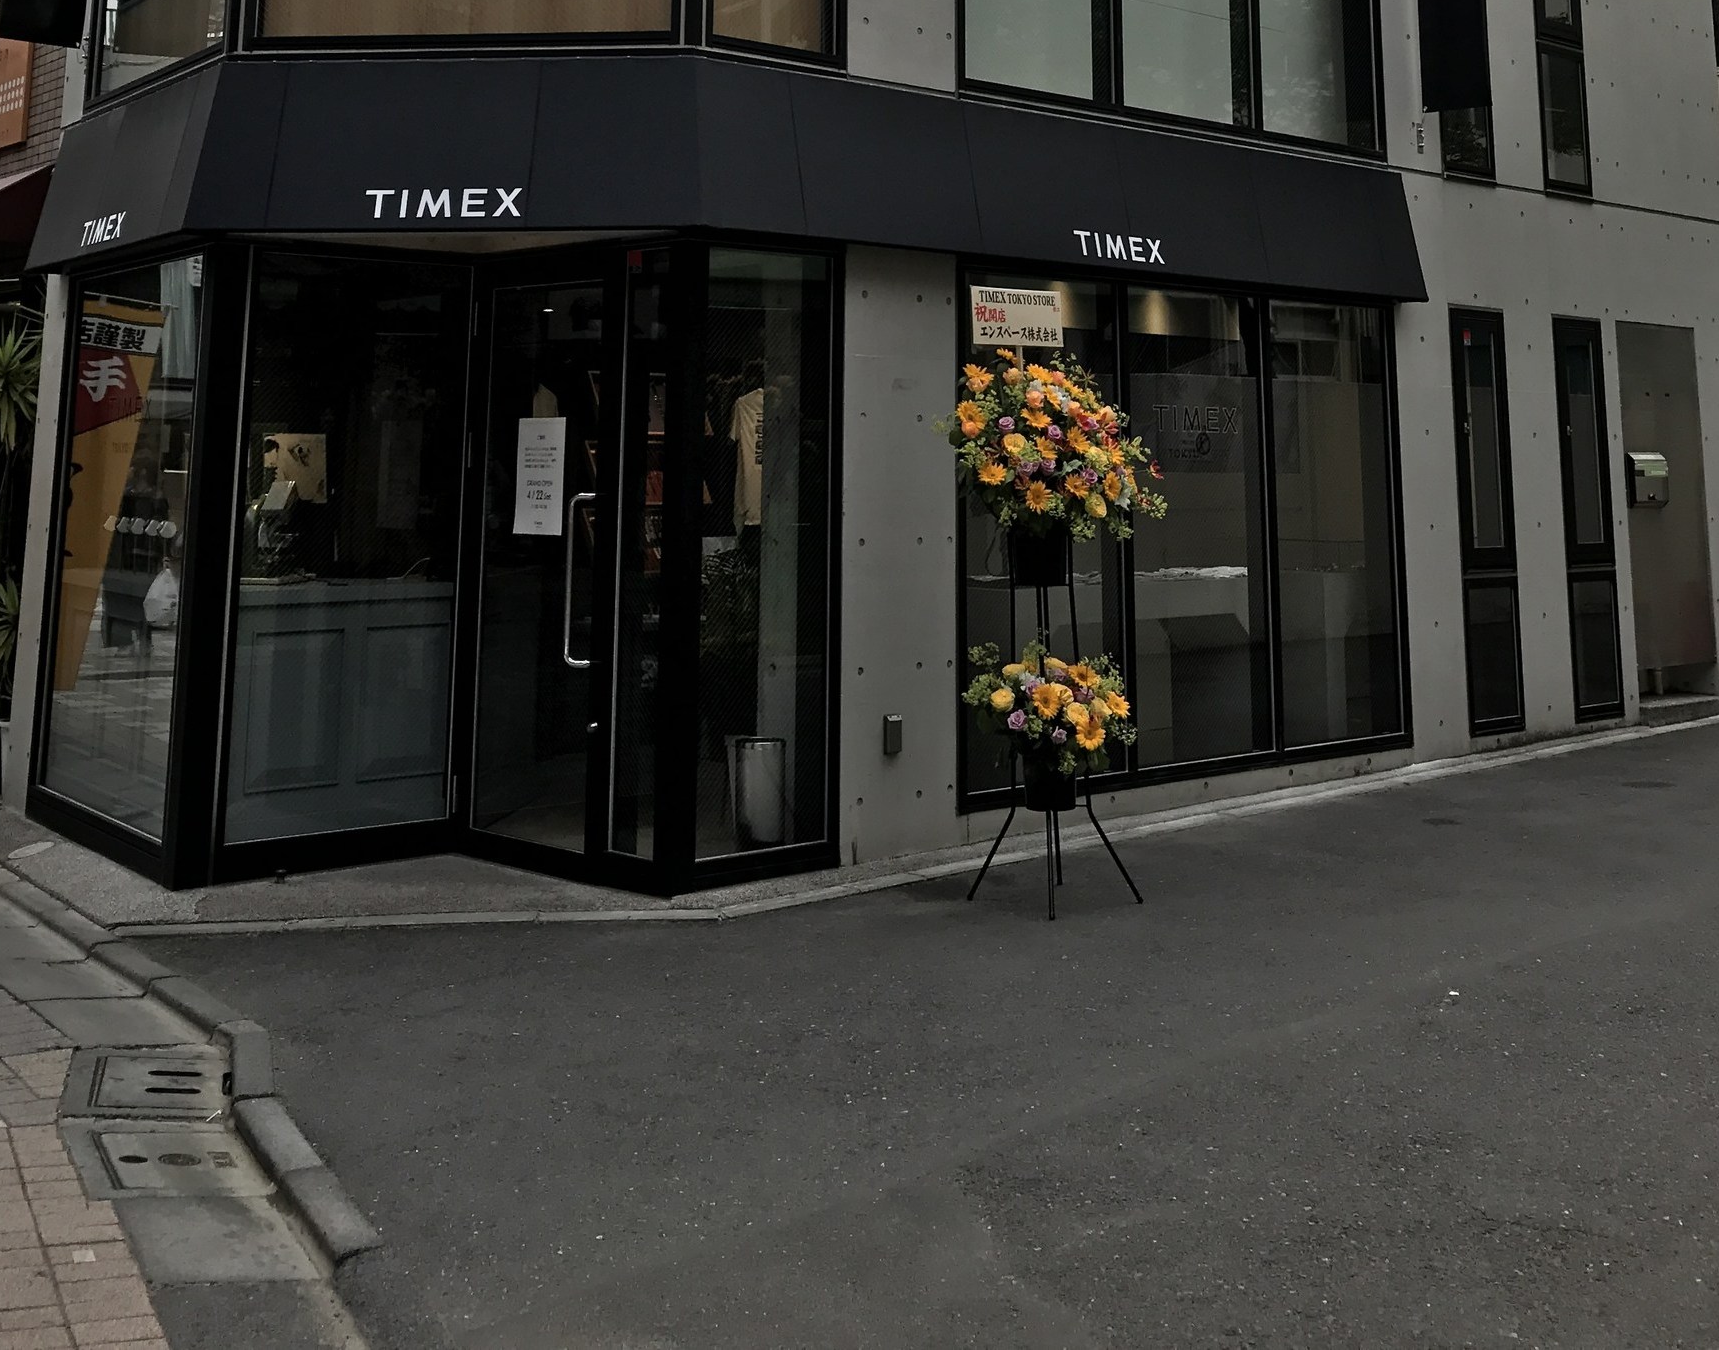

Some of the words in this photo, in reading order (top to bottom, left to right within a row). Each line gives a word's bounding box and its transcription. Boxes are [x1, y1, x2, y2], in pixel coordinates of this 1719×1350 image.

[364, 187, 524, 220] TIMEX
[81, 210, 127, 247] TIMEX
[1073, 229, 1166, 265] TIMEX
[979, 290, 1007, 304] TIMEX
[1007, 293, 1032, 306] TOKYO
[1032, 295, 1056, 307] STORE
[1153, 405, 1238, 434] TIMEX
